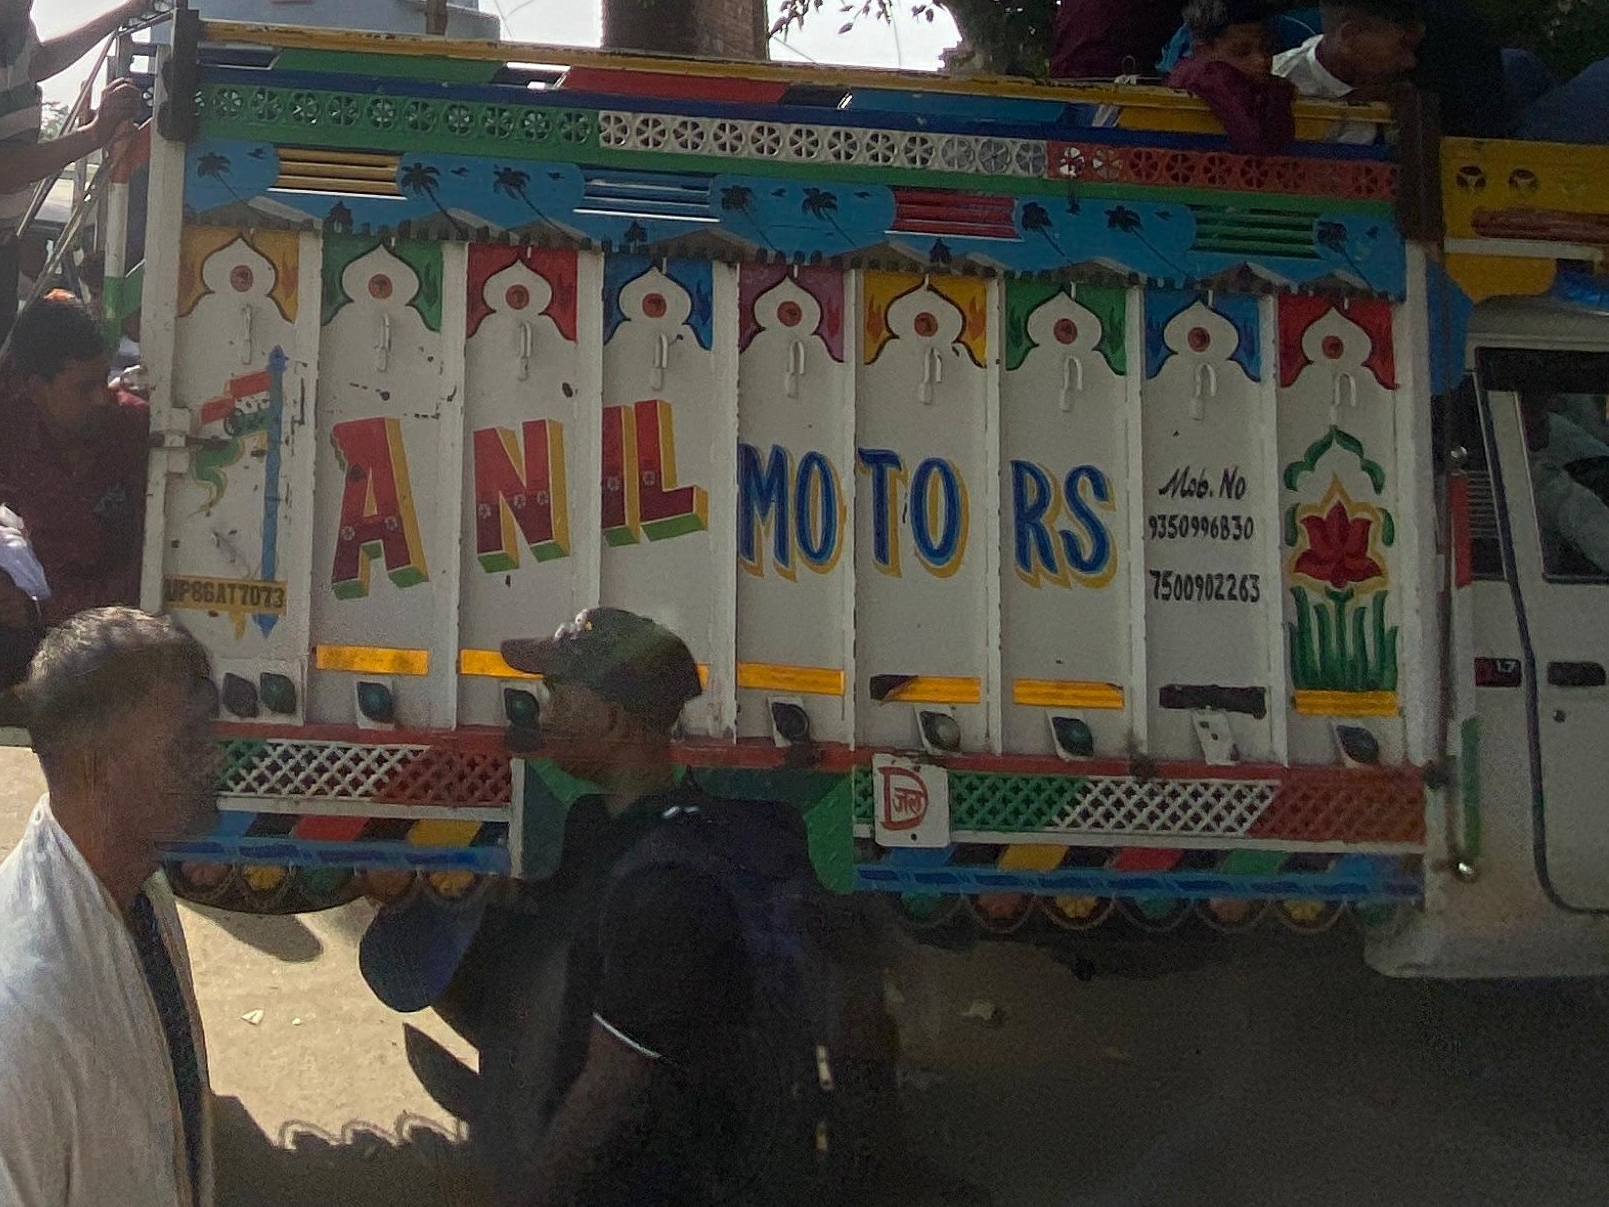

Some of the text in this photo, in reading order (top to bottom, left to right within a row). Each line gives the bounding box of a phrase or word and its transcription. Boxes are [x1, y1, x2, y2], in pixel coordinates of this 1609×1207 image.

[330, 398, 709, 600] ANIL
[1218, 465, 1247, 500] No
[1149, 514, 1255, 541] 9350996830
[1149, 569, 1261, 603] 7500902263
